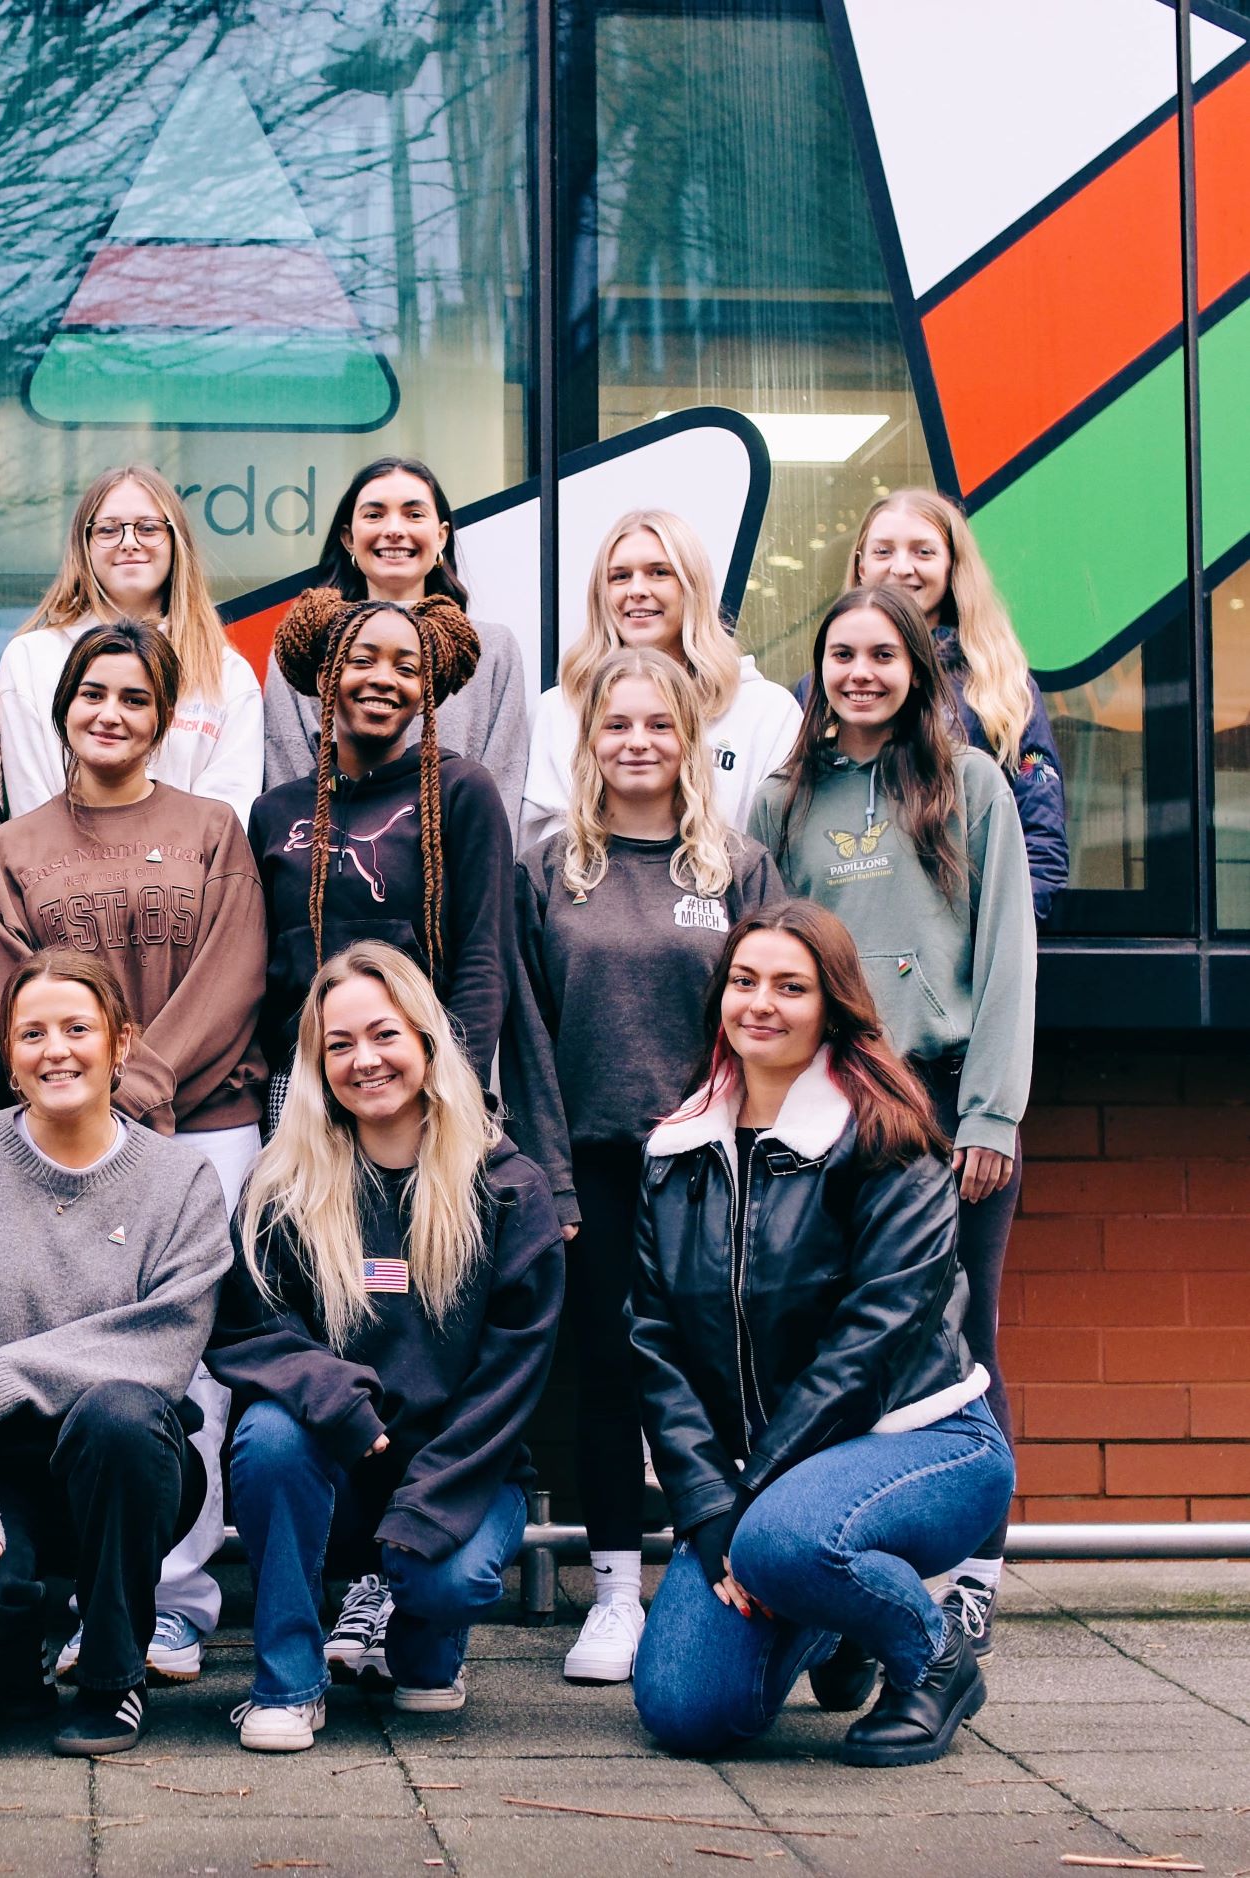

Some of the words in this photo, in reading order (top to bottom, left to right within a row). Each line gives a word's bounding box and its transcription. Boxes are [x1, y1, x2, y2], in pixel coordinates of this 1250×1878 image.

[173, 465, 316, 537] rdd
[64, 872, 92, 888] NEW
[97, 869, 131, 883] YORK
[135, 865, 165, 879] CITY
[830, 857, 889, 876] PAPILLONS
[681, 910, 720, 929] MERCH
